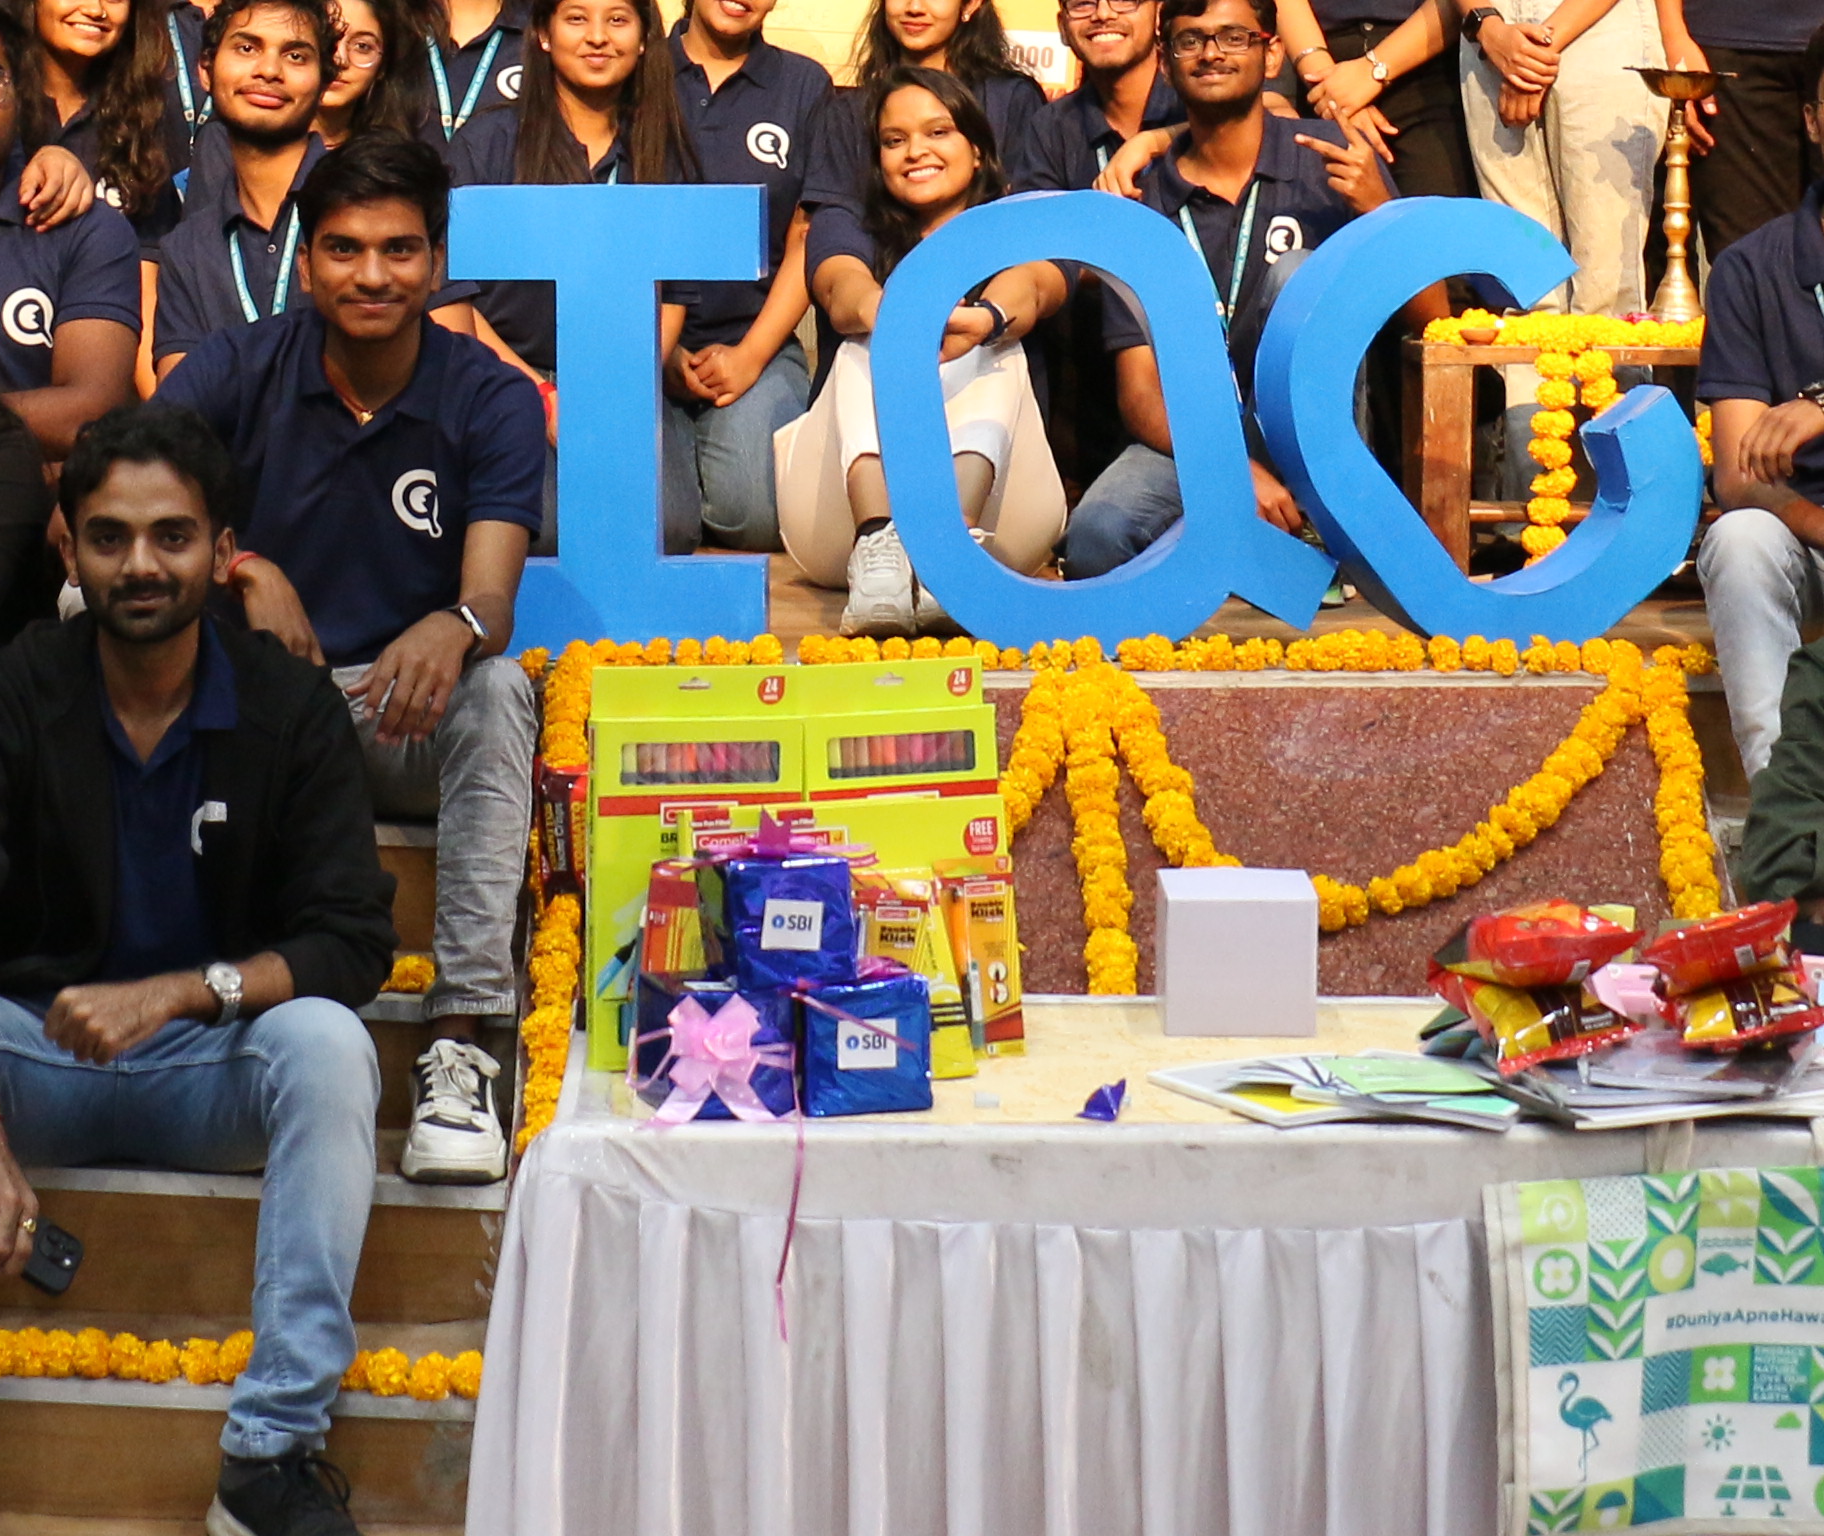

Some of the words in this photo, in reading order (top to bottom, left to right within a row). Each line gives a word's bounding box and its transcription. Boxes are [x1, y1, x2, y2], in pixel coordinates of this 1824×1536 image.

[953, 670, 967, 685] 24
[764, 678, 778, 693] 24
[969, 820, 993, 835] FREE
[787, 914, 813, 931] SBI
[861, 1033, 888, 1050] SBI
